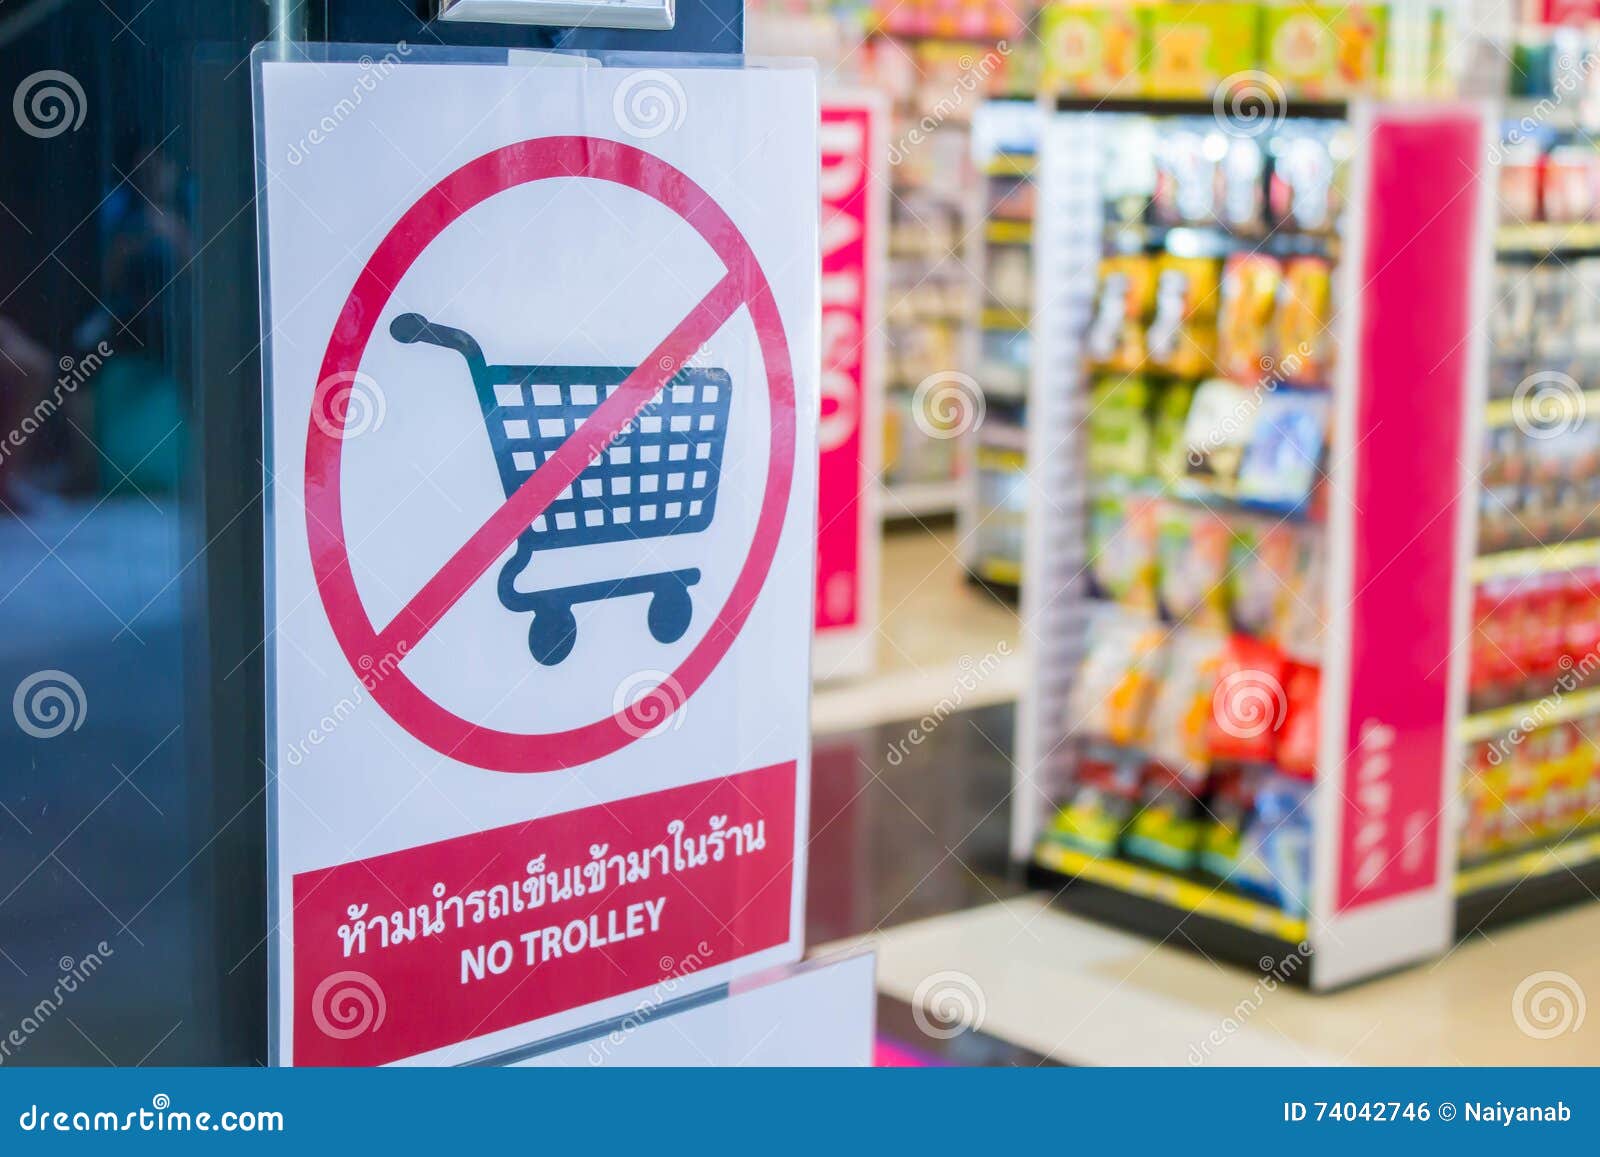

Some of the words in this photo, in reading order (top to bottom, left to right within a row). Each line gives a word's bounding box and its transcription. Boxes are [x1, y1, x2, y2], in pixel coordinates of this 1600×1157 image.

[337, 815, 767, 958] ห้ามนำรถเข็นเข้ามาในร้าน
[459, 938, 514, 984] NO
[520, 897, 667, 966] TROLLEY
